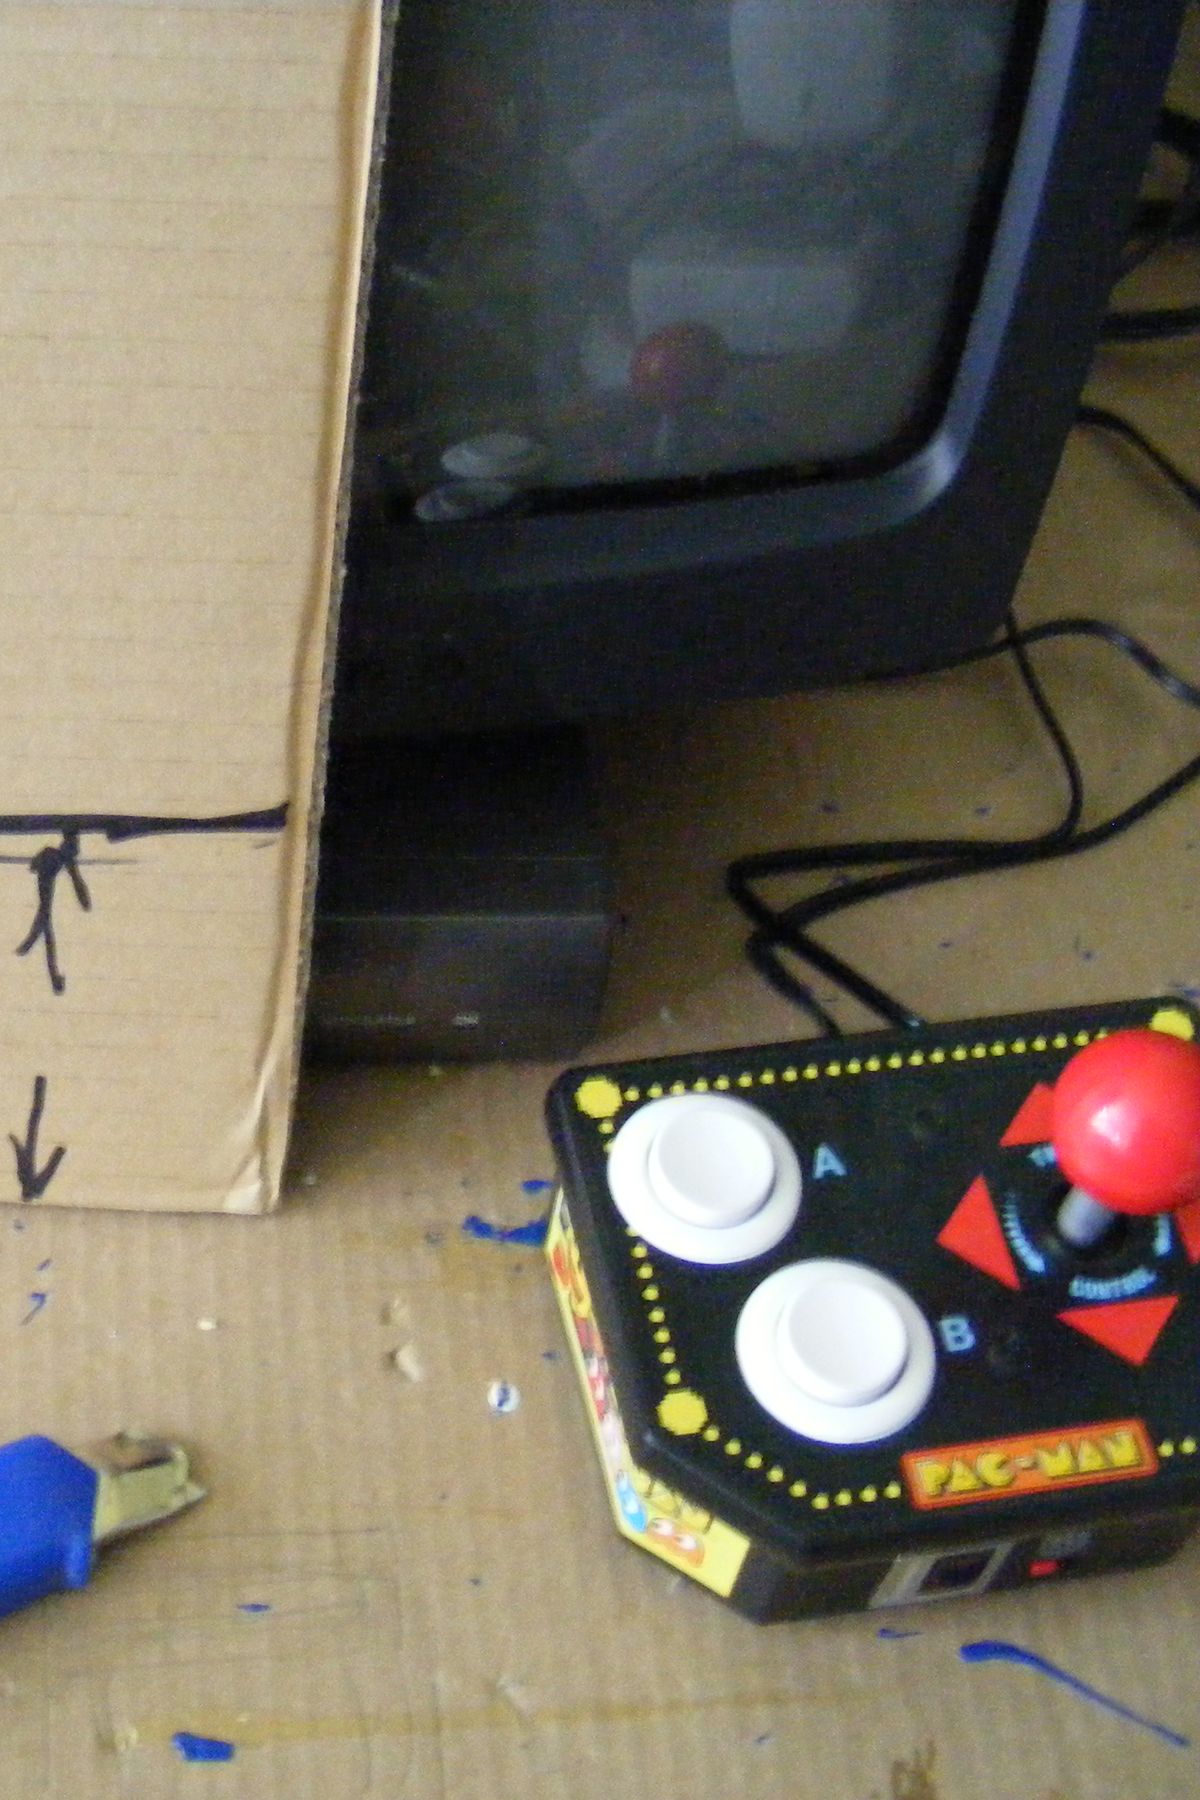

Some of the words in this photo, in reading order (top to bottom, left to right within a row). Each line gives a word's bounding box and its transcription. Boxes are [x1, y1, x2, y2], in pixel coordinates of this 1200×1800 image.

[813, 1142, 848, 1180] A
[938, 1313, 977, 1353] B
[914, 1430, 1142, 1497] PAC-MAN
